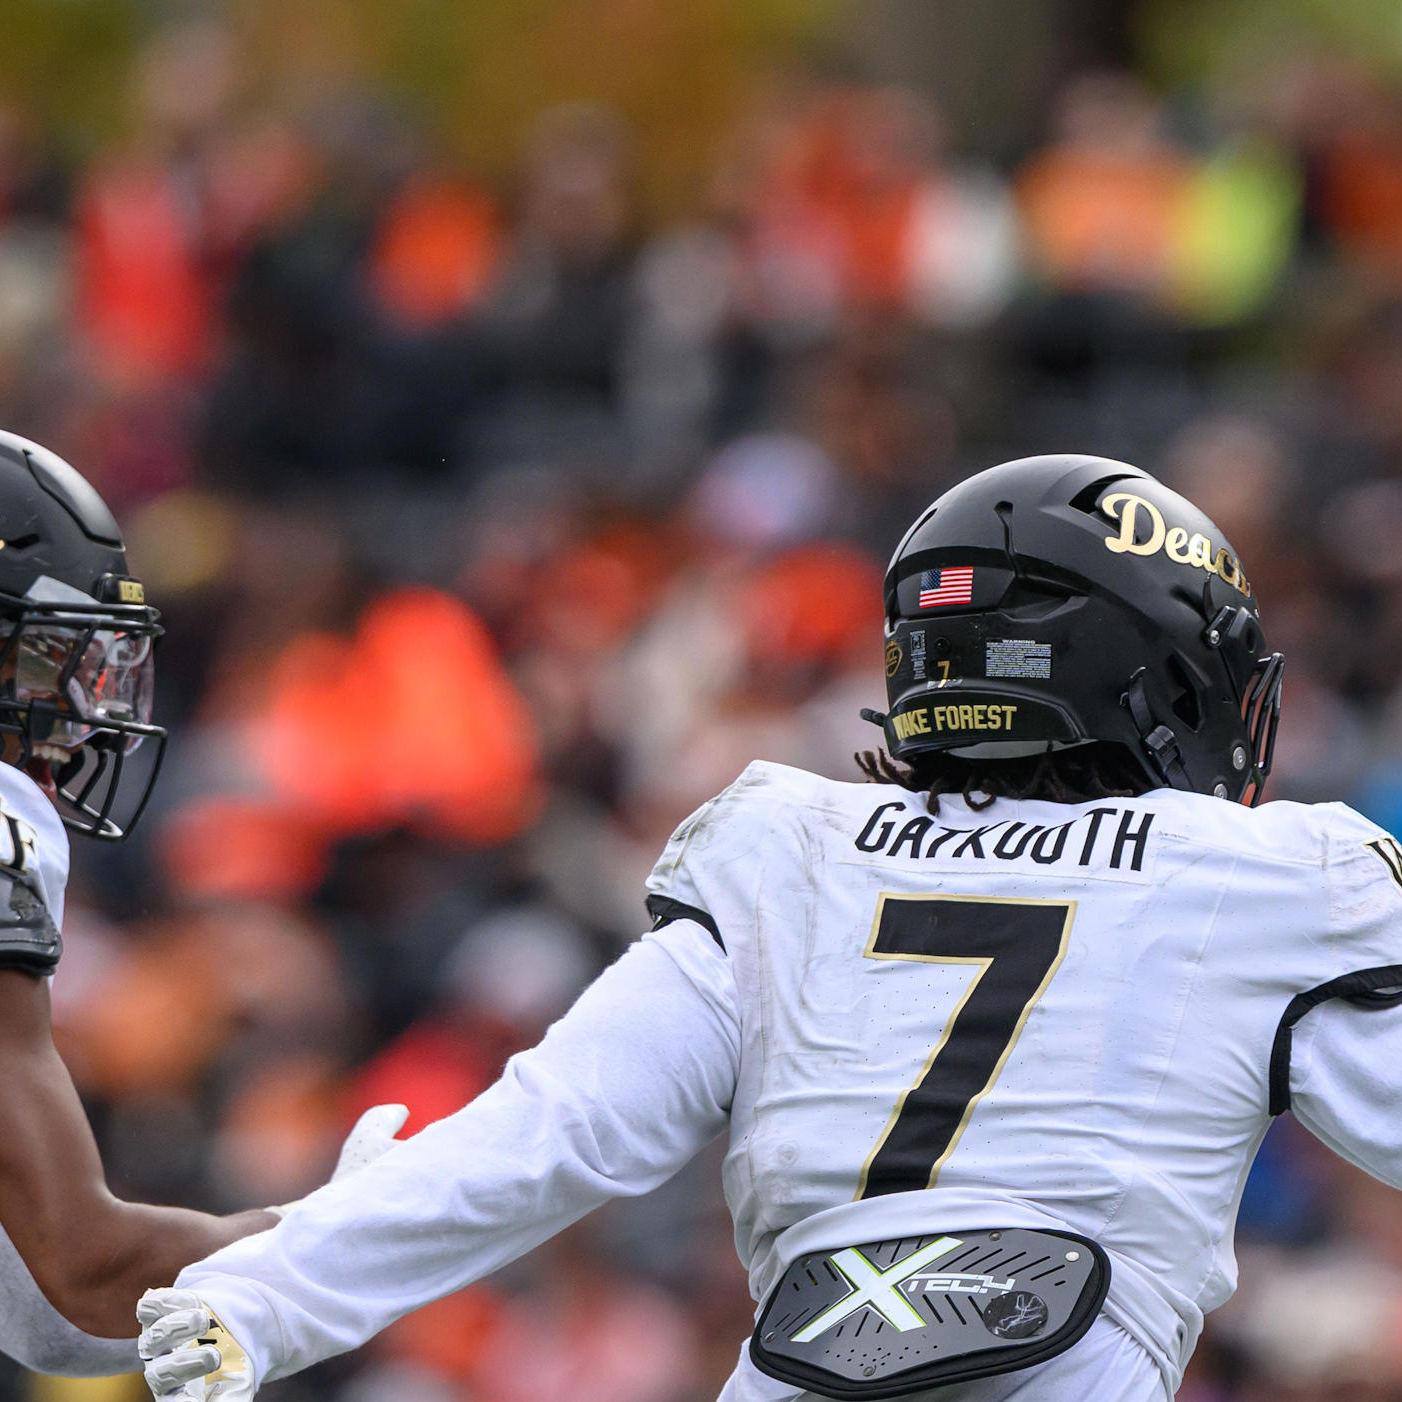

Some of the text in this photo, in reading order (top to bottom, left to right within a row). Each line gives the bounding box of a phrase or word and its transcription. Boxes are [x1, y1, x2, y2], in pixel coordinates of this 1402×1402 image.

[892, 704, 1018, 740] WAKE FOREST
[852, 891, 1078, 1203] 7
